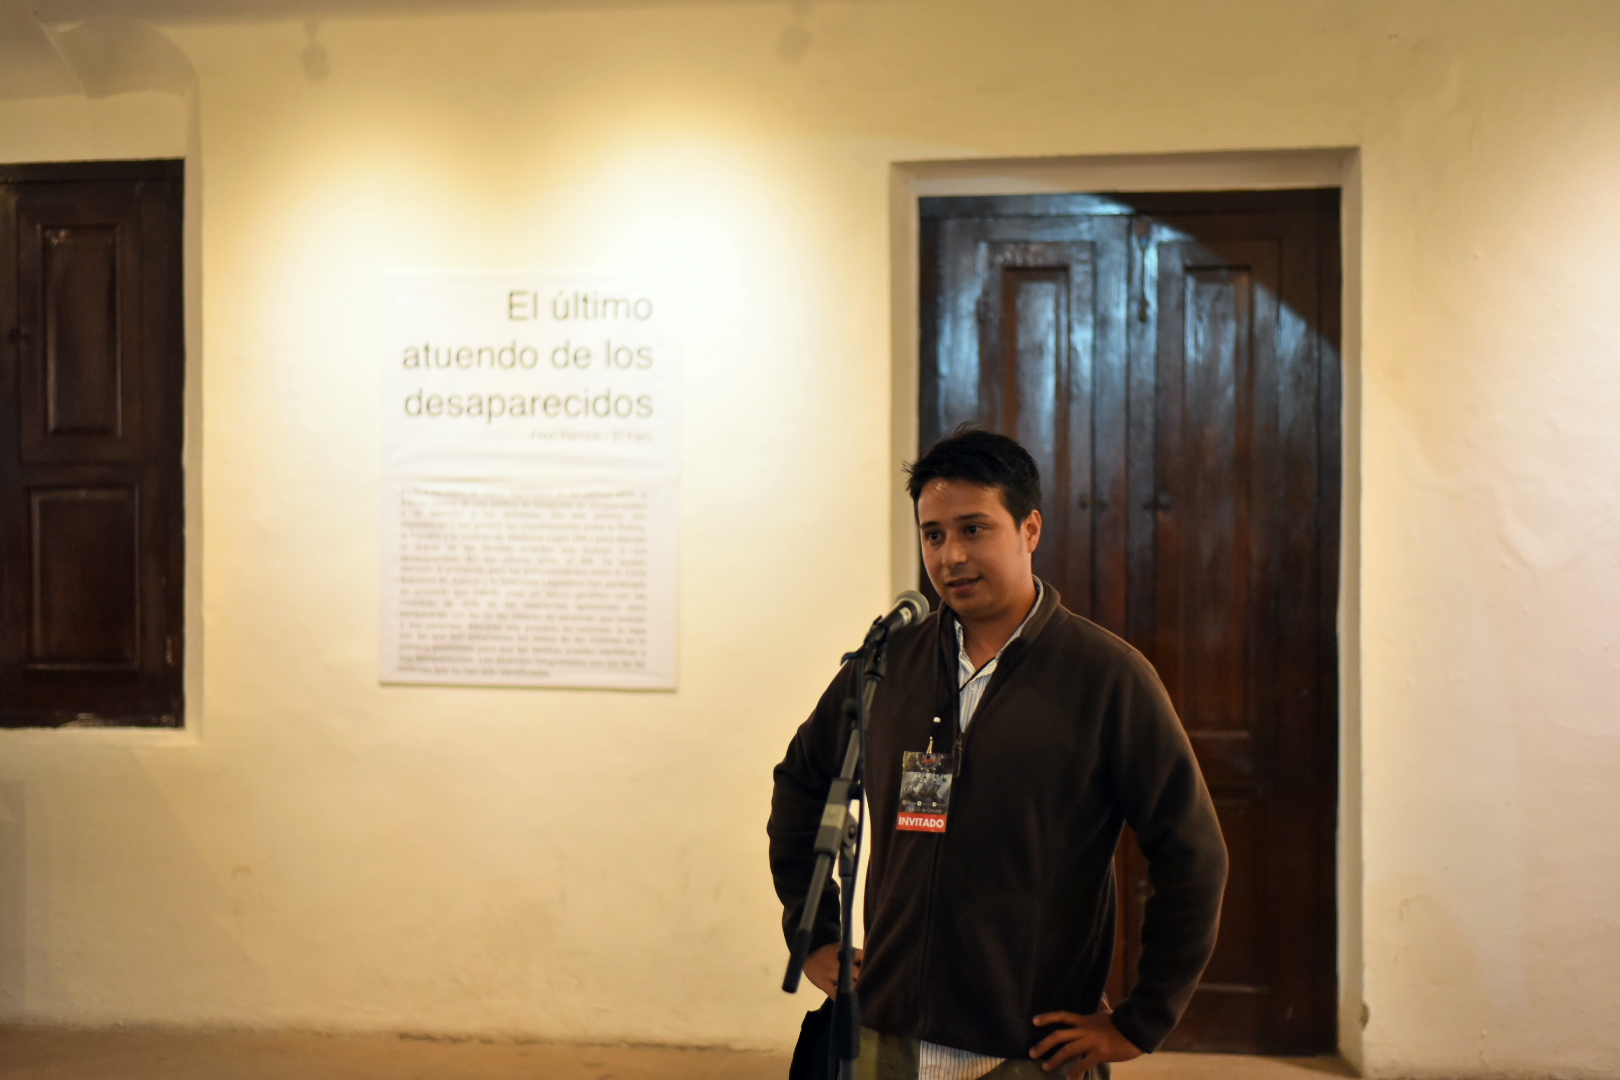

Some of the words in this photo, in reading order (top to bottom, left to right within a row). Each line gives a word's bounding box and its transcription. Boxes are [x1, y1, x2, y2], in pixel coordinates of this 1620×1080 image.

[508, 290, 538, 321] El
[551, 290, 654, 321] último
[402, 340, 539, 371] atuendo
[551, 340, 592, 371] de
[605, 339, 654, 371] los
[403, 387, 654, 424] desaparecidos
[898, 816, 944, 828] INVITADO
